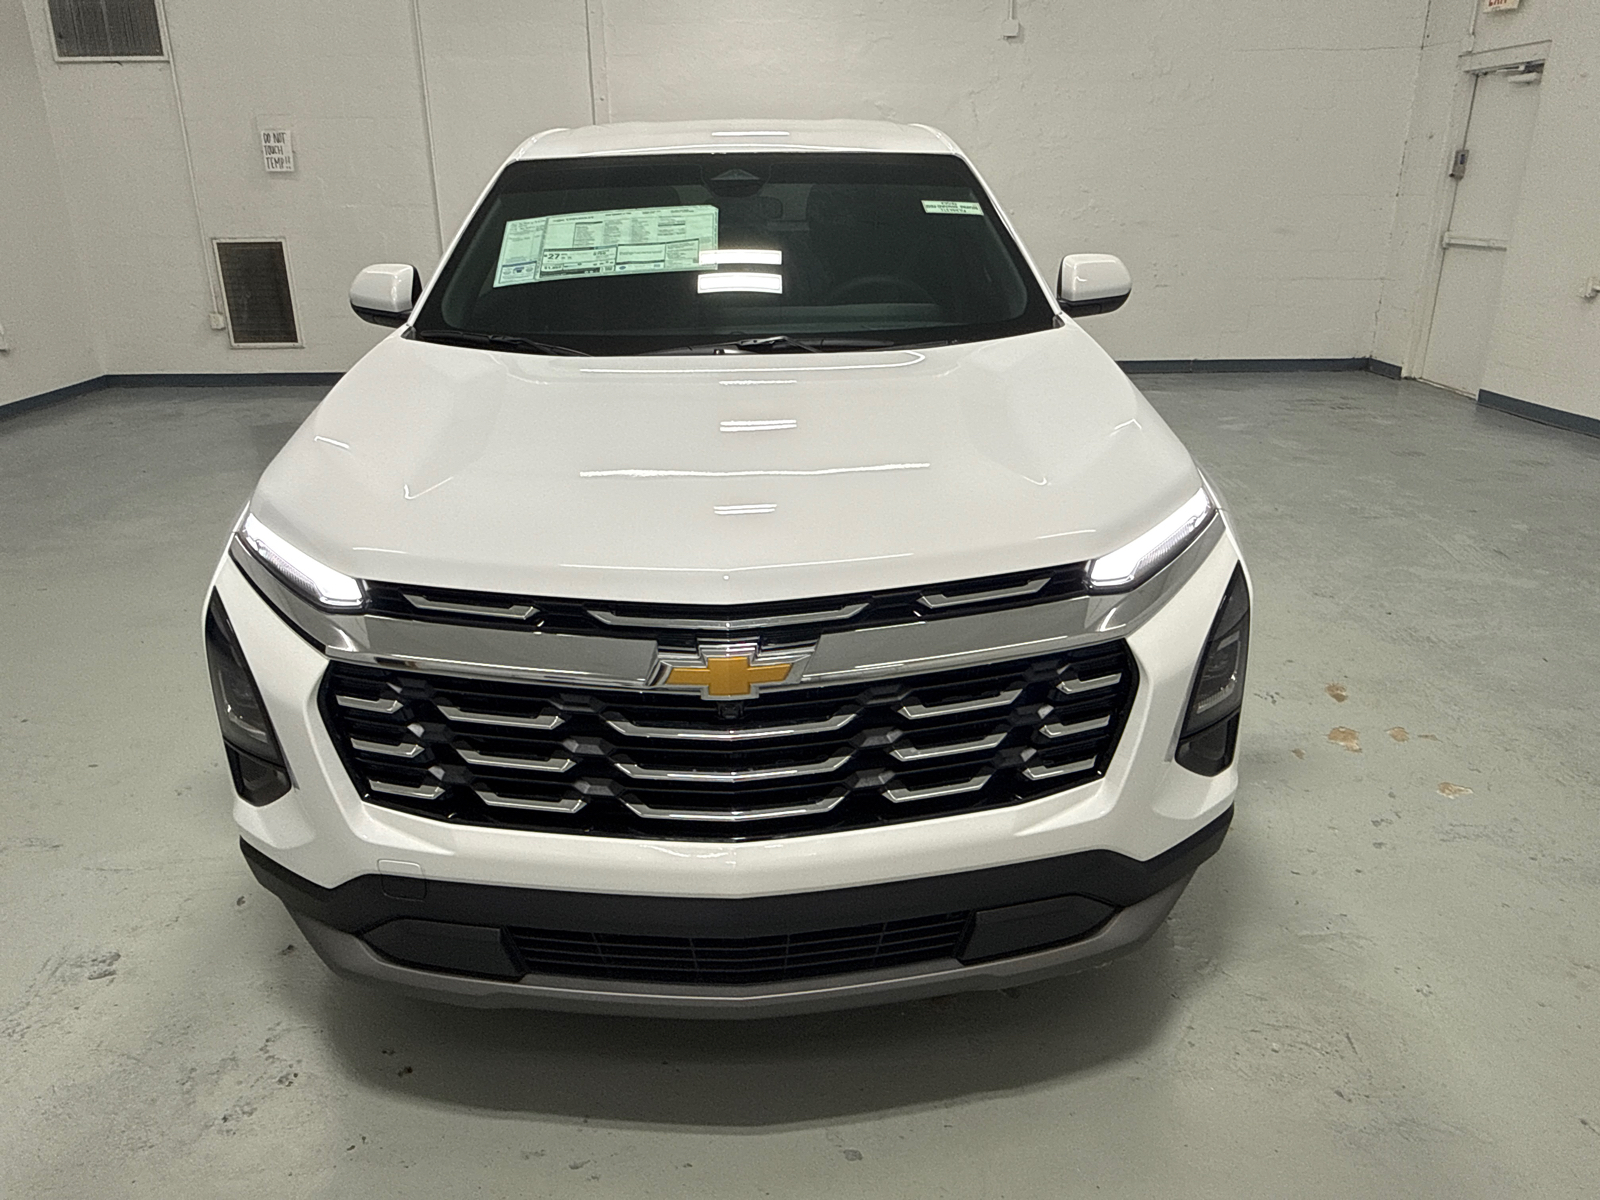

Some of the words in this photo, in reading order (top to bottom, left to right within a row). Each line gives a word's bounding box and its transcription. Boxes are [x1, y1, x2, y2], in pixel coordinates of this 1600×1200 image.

[263, 133, 271, 144] DO
[273, 132, 286, 144] NOT
[264, 145, 284, 156] TOUCH
